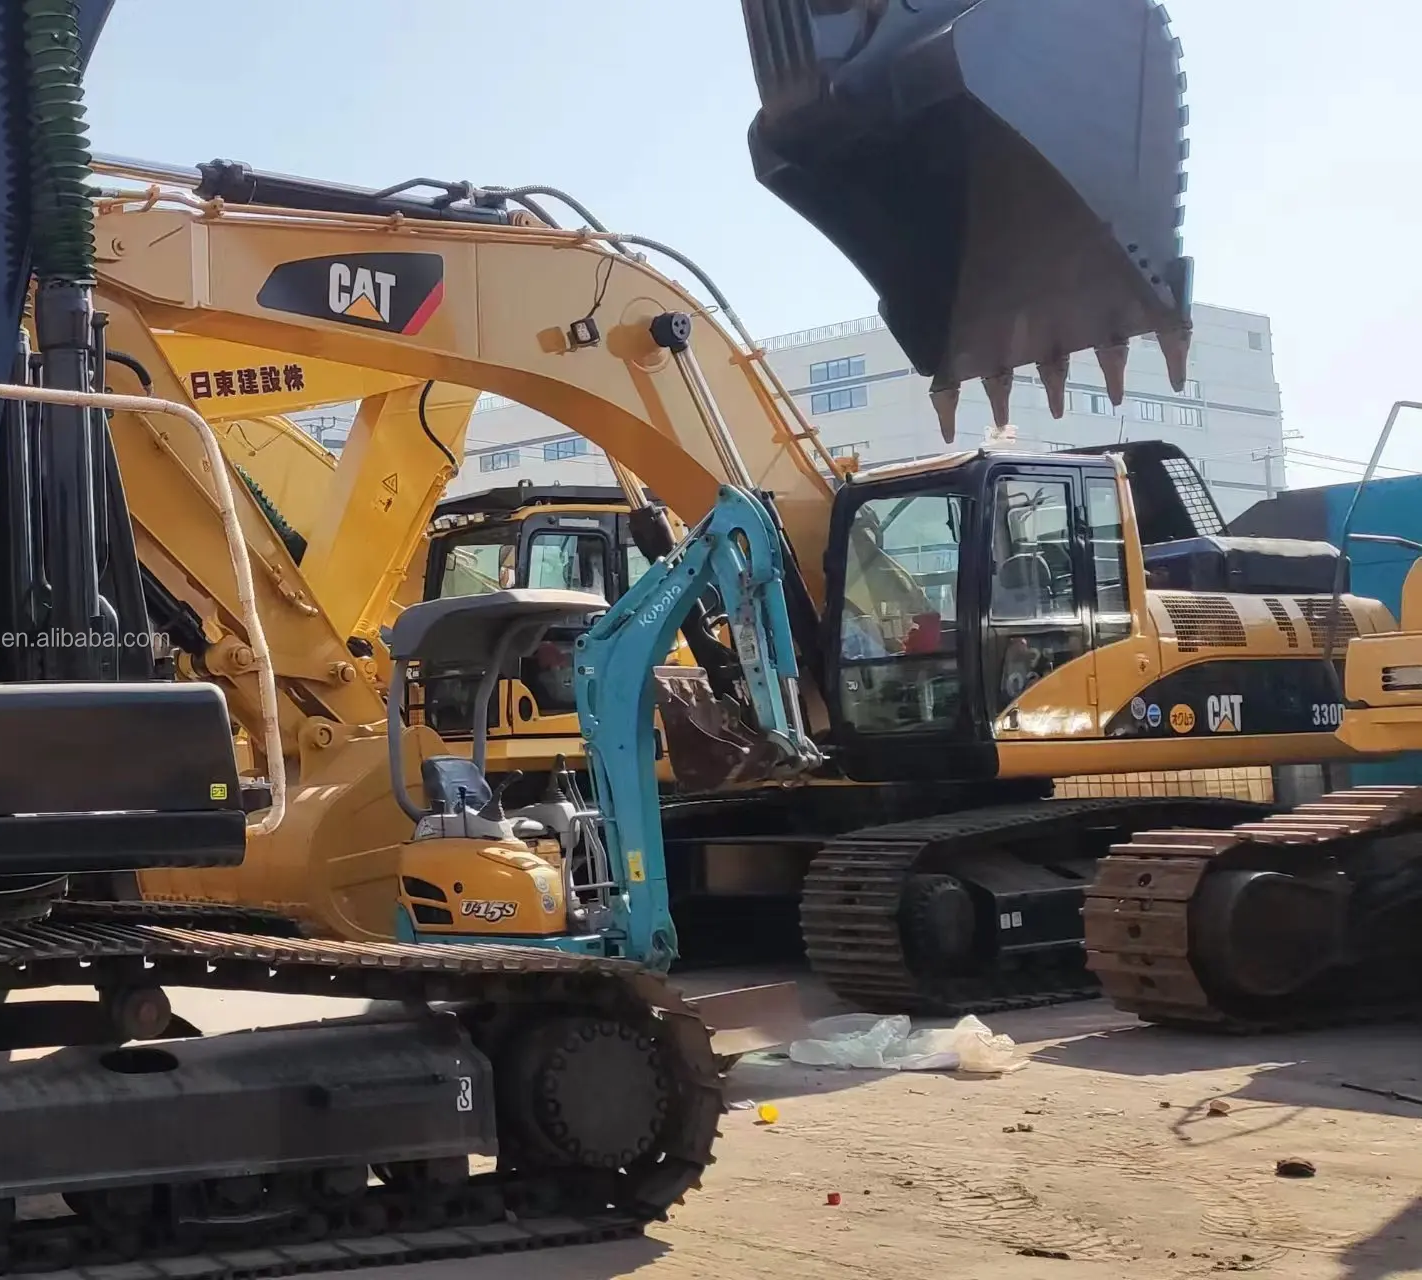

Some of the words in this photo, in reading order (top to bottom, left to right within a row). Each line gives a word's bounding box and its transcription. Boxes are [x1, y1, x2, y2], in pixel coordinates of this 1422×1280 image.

[329, 263, 396, 323] CAT
[190, 364, 304, 399] 日東建設株
[638, 585, 682, 627] Kubota
[1207, 695, 1243, 732] CAT
